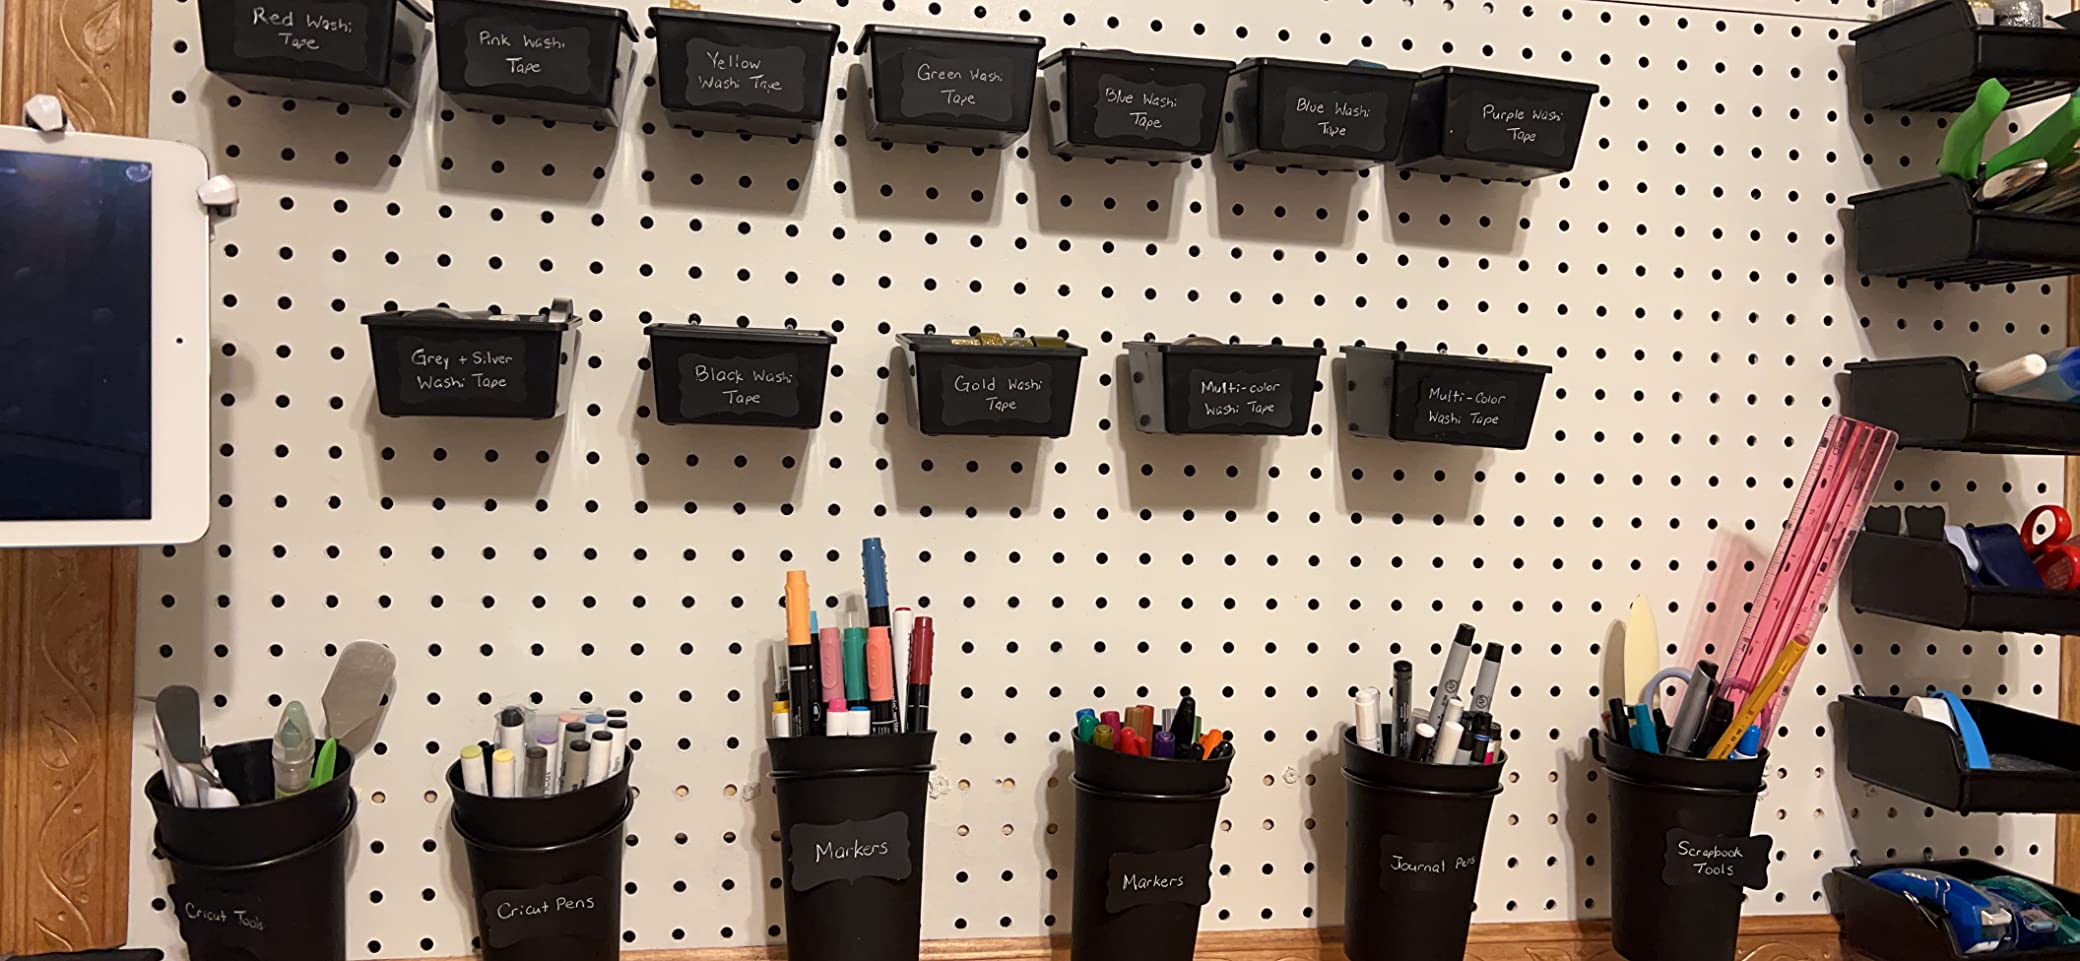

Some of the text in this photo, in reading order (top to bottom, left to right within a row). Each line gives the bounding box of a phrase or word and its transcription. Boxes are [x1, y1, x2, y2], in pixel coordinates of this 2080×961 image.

[253, 7, 294, 27] Red
[278, 33, 320, 49] Tape
[480, 30, 511, 47] Pink
[505, 57, 542, 74] Tape
[706, 51, 761, 70] Yellow
[917, 63, 962, 80] Green
[749, 74, 783, 94] Tape
[940, 89, 976, 106] Tape
[1105, 88, 1134, 104] Blue
[1296, 97, 1371, 118] Blue Washi
[1482, 104, 1525, 123] Purple
[1129, 112, 1163, 131] Tape
[1317, 121, 1347, 137] Tape
[1506, 127, 1536, 143] Tape
[411, 348, 513, 370] Grey + Silver
[416, 372, 507, 390] Washi Tape
[695, 364, 744, 384] Black
[954, 375, 996, 393] Gold
[722, 389, 761, 405] Tape
[985, 396, 1017, 412] Tape
[1246, 401, 1275, 415] Tape
[1429, 410, 1499, 426] Washi Tape
[815, 839, 888, 863] Markers
[1678, 840, 1743, 858] Scrapbook
[1390, 855, 1445, 873] Journal
[1693, 862, 1734, 876] Tools
[1122, 873, 1184, 891] Markers
[185, 902, 263, 931] Cricut Tools
[497, 896, 595, 920] Cricut Pens
